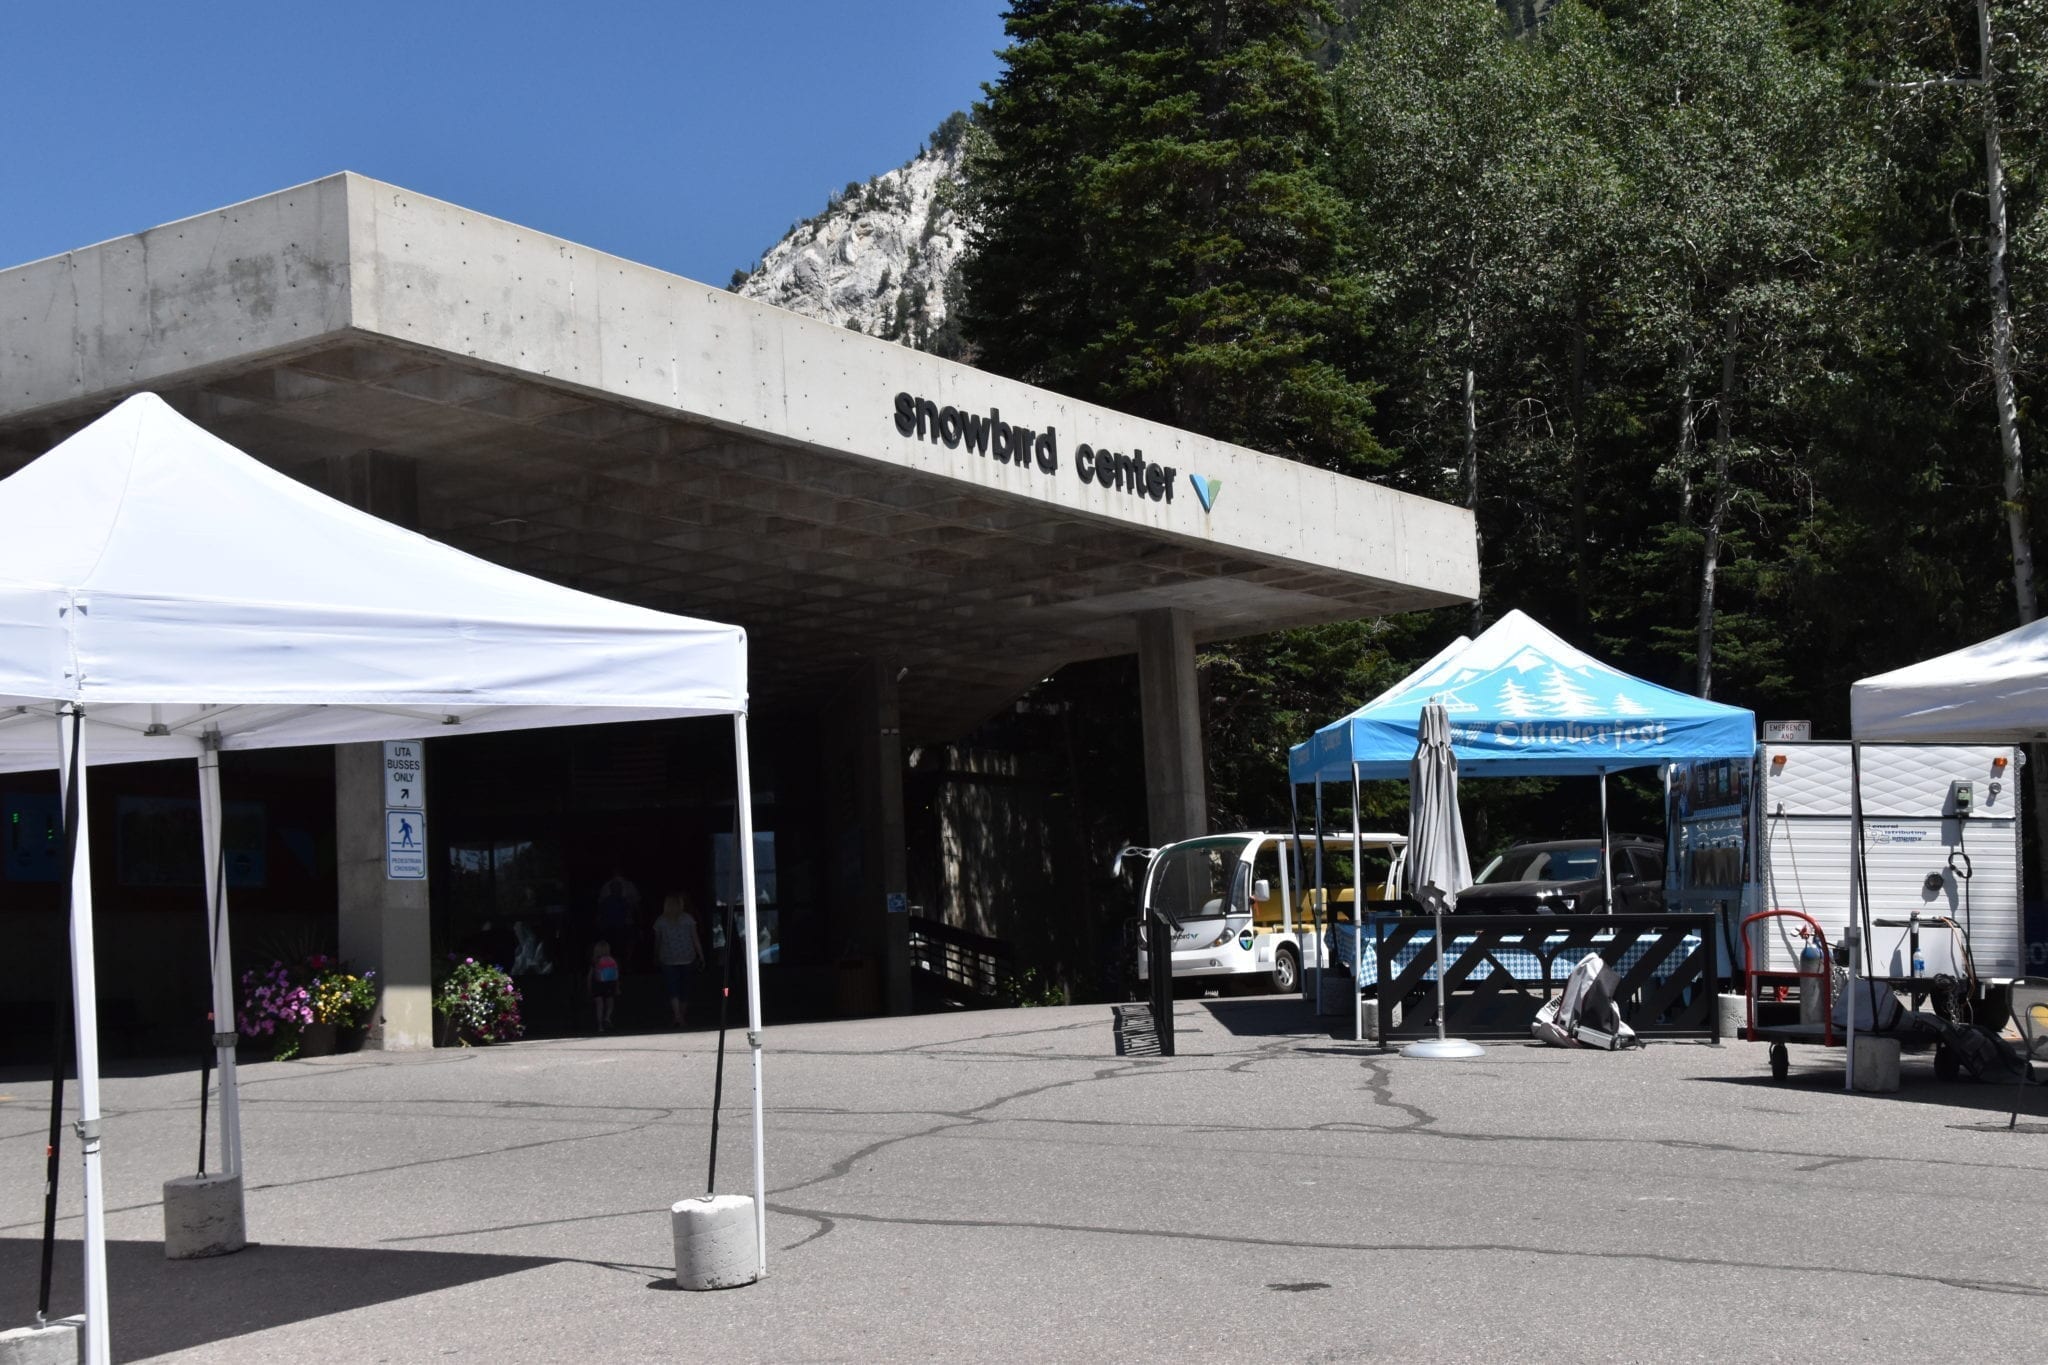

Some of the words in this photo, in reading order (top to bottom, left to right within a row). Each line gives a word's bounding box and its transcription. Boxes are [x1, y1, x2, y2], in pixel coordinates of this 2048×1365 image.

[894, 392, 1058, 476] snowbird
[1075, 443, 1177, 504] center
[1769, 723, 1807, 732] EMERGENCY
[394, 747, 412, 757] UTA
[387, 759, 420, 771] BUSSES
[393, 772, 415, 783] ONLY
